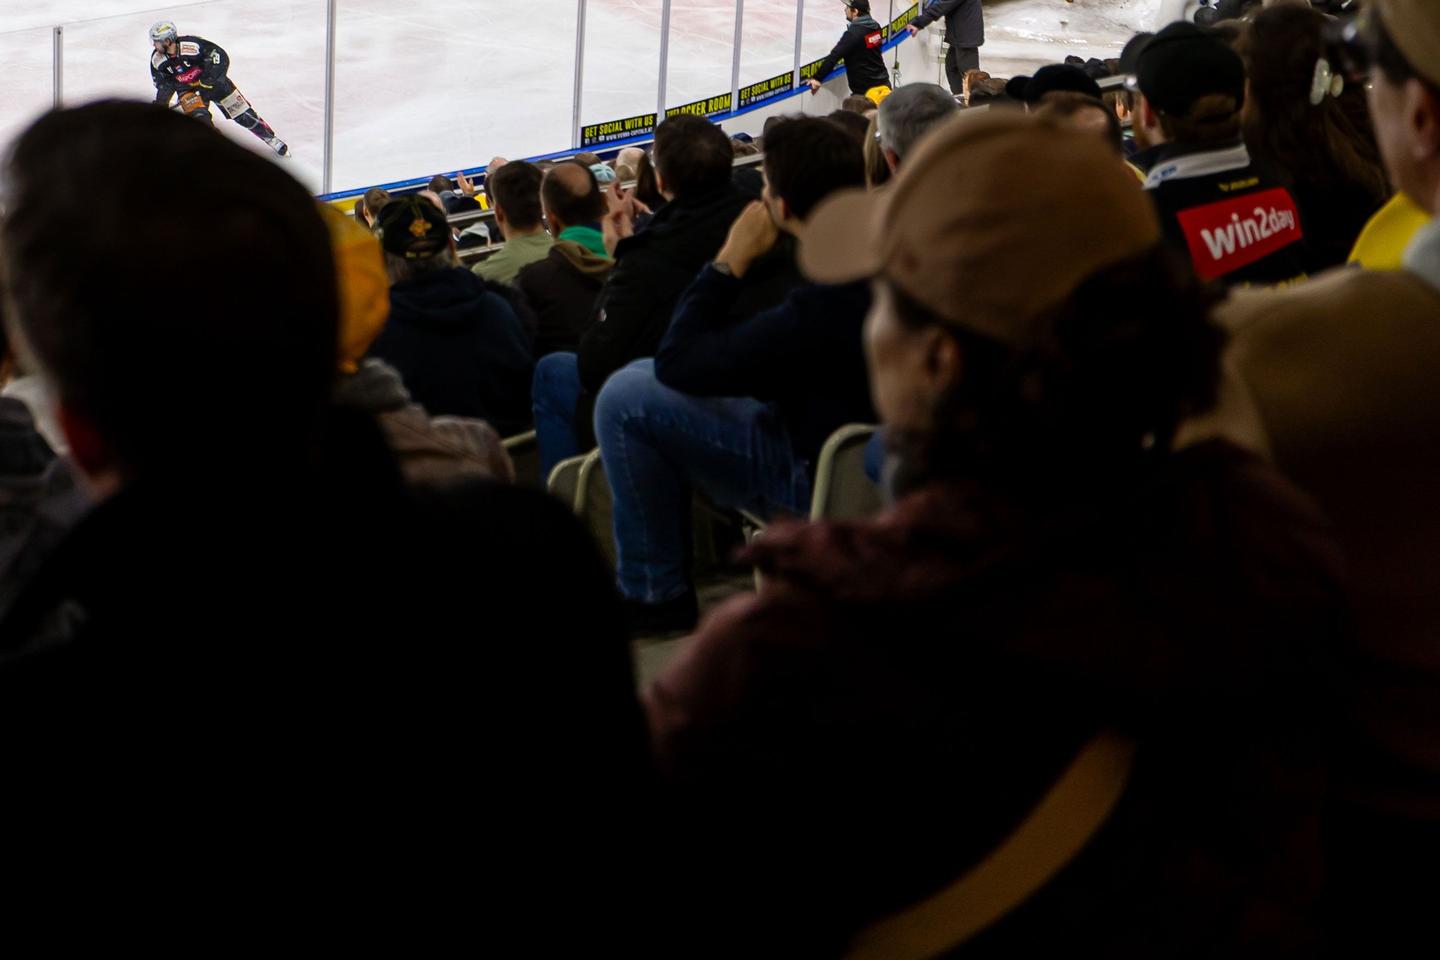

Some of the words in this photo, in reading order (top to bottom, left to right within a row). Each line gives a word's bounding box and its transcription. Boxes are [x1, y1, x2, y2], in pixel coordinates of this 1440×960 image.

[708, 94, 731, 113] ROOM
[741, 87, 750, 100] GET
[585, 126, 597, 138] GET
[600, 121, 623, 135] SOCIAL
[625, 118, 643, 129] WITH
[644, 116, 653, 126] US
[1201, 206, 1295, 260] win2day
